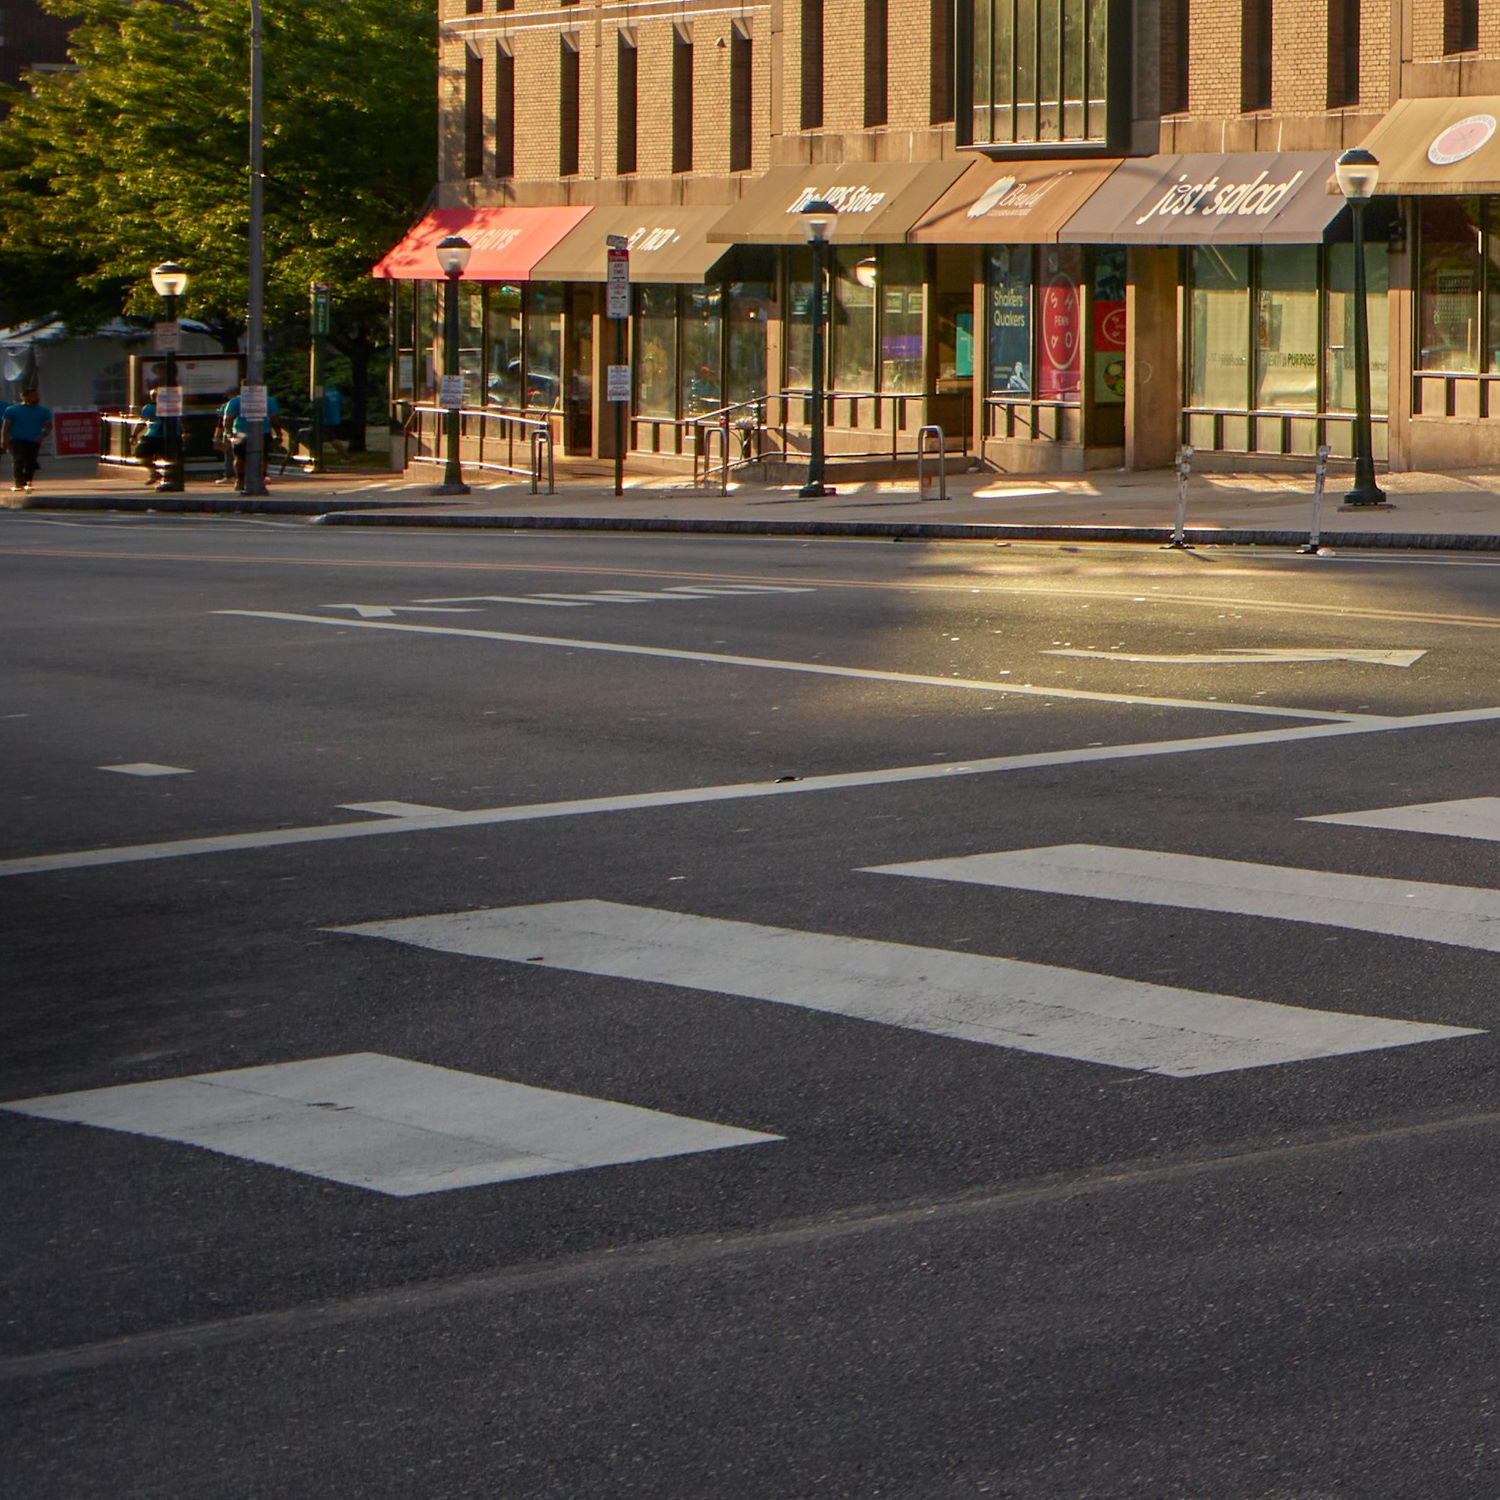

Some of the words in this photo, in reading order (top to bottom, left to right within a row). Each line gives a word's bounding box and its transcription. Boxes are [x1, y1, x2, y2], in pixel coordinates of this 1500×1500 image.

[838, 185, 886, 213] Store
[1136, 174, 1220, 226] just
[1202, 170, 1304, 216] salad
[472, 228, 522, 250] GUYS
[637, 227, 676, 251] TACO
[993, 289, 1023, 308] Shakers
[993, 310, 1025, 327] Quakers
